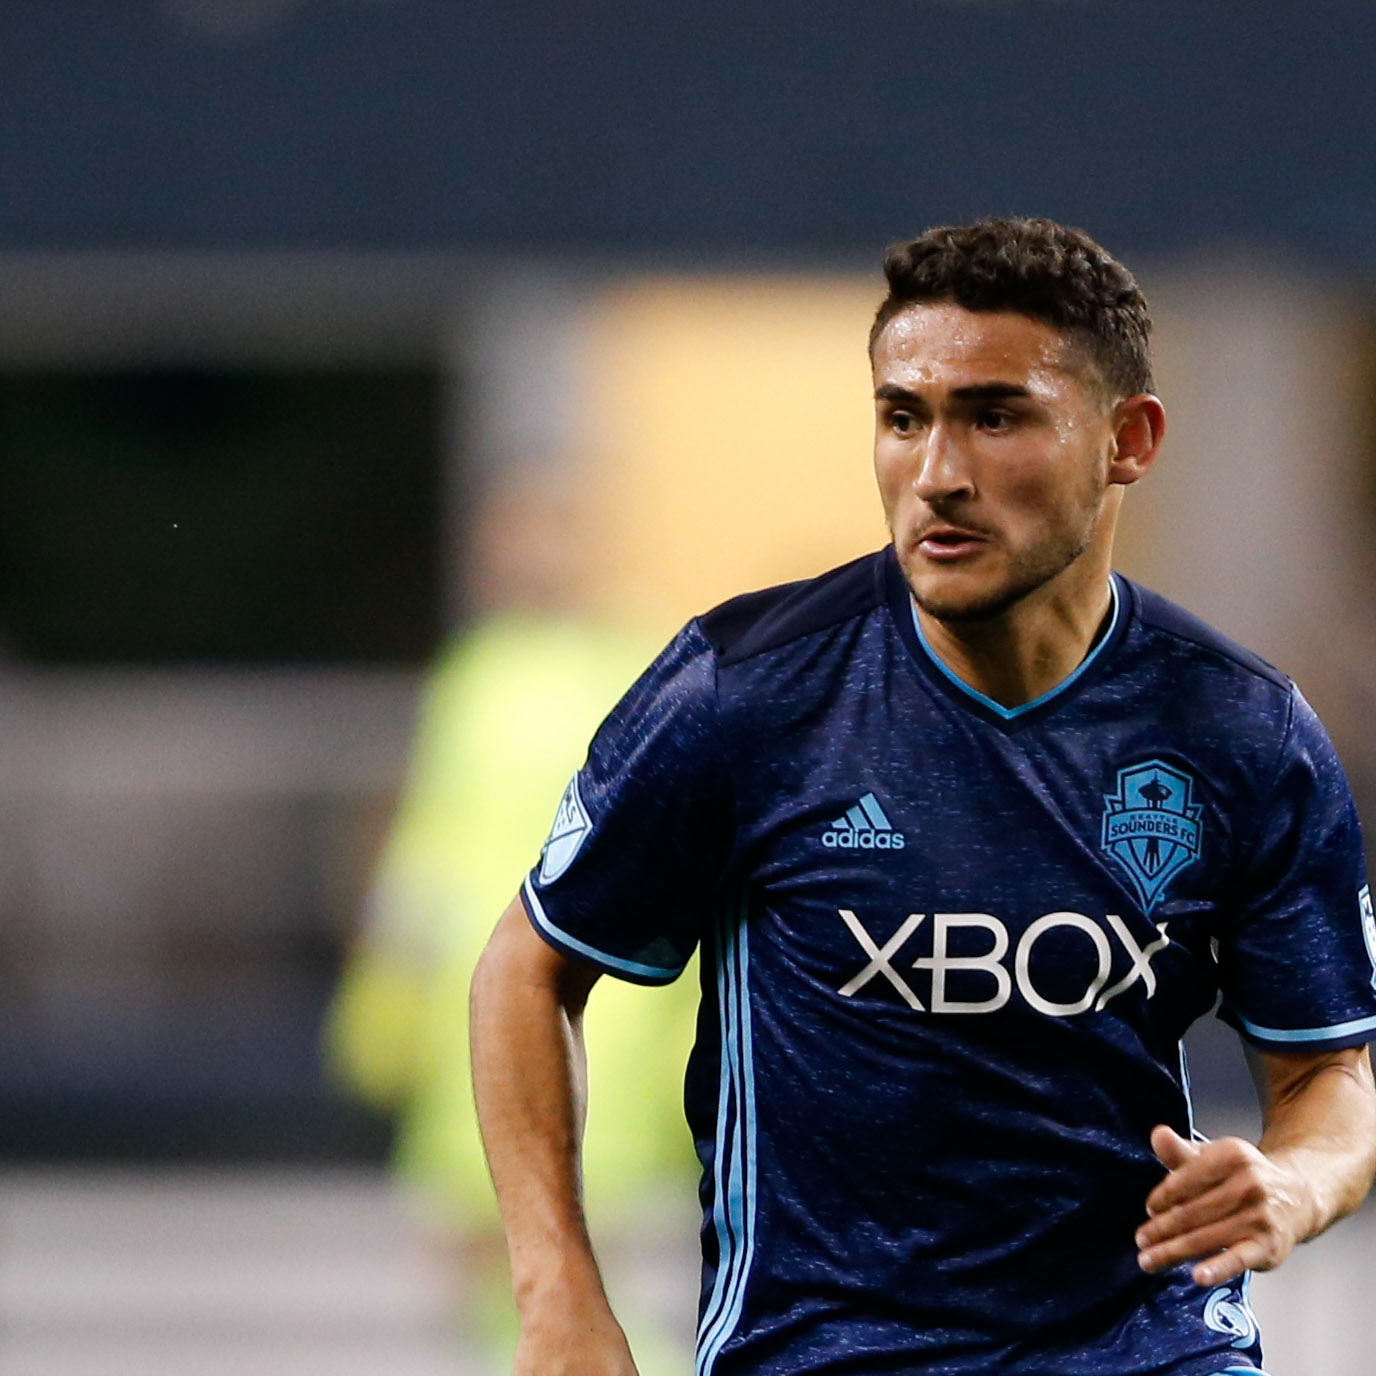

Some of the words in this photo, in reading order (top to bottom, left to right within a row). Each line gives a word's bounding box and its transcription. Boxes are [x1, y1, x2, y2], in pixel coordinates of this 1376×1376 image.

[821, 828, 905, 849] adidas
[1110, 820, 1178, 838] SOUNDERS
[1180, 828, 1195, 845] FC
[837, 908, 1170, 1016] XBOX
